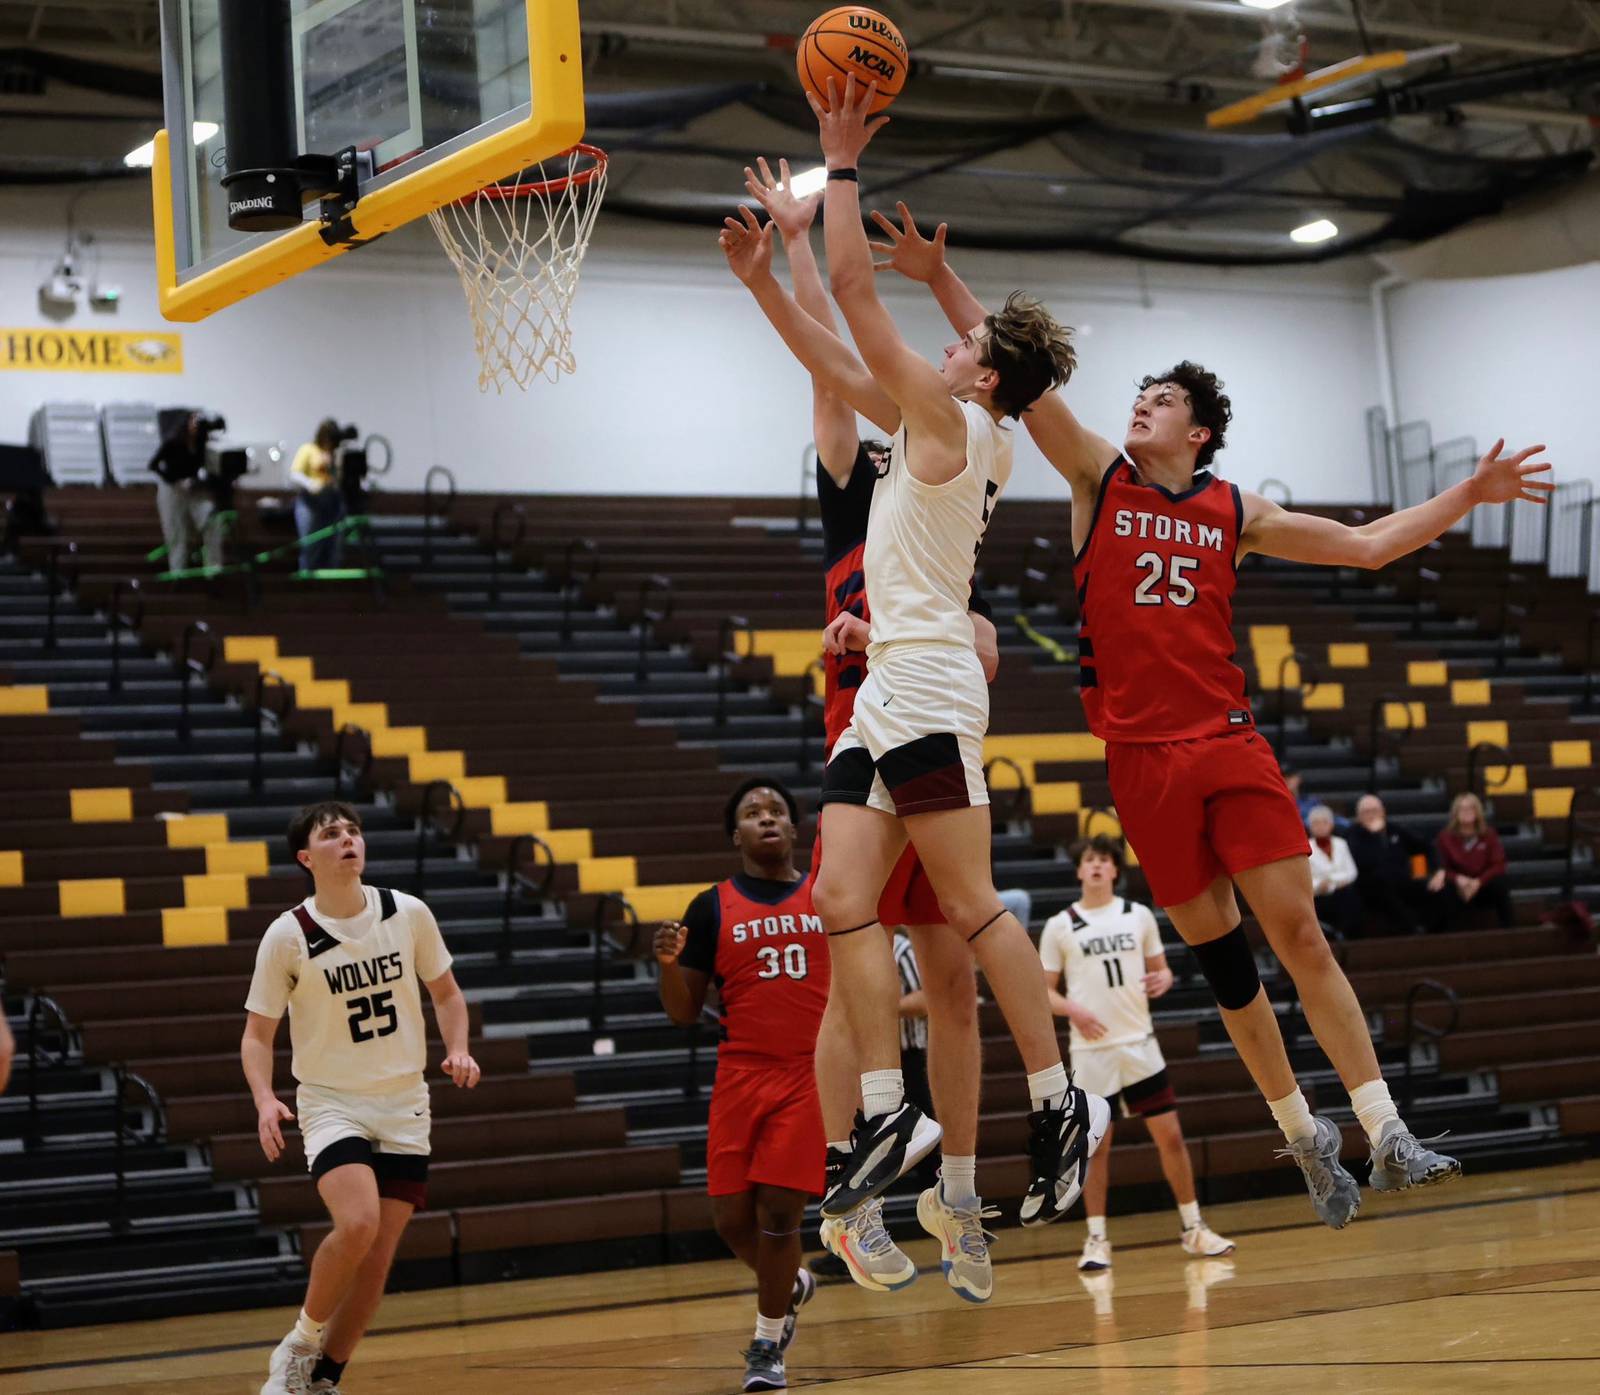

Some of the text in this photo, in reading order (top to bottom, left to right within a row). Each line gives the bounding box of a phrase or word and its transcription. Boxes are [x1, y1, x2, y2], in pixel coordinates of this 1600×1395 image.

[848, 15, 906, 57] Wilson
[848, 45, 896, 81] NCAA
[229, 195, 274, 215] SPALDING
[7, 333, 122, 367] HOME
[1114, 509, 1223, 552] STORM
[1134, 551, 1199, 607] 25
[732, 913, 824, 943] STORM
[1079, 932, 1136, 957] WOLVES
[323, 951, 403, 995] WOLVES
[756, 943, 808, 980] 30
[1103, 957, 1124, 989] 11
[346, 989, 398, 1044] 25
